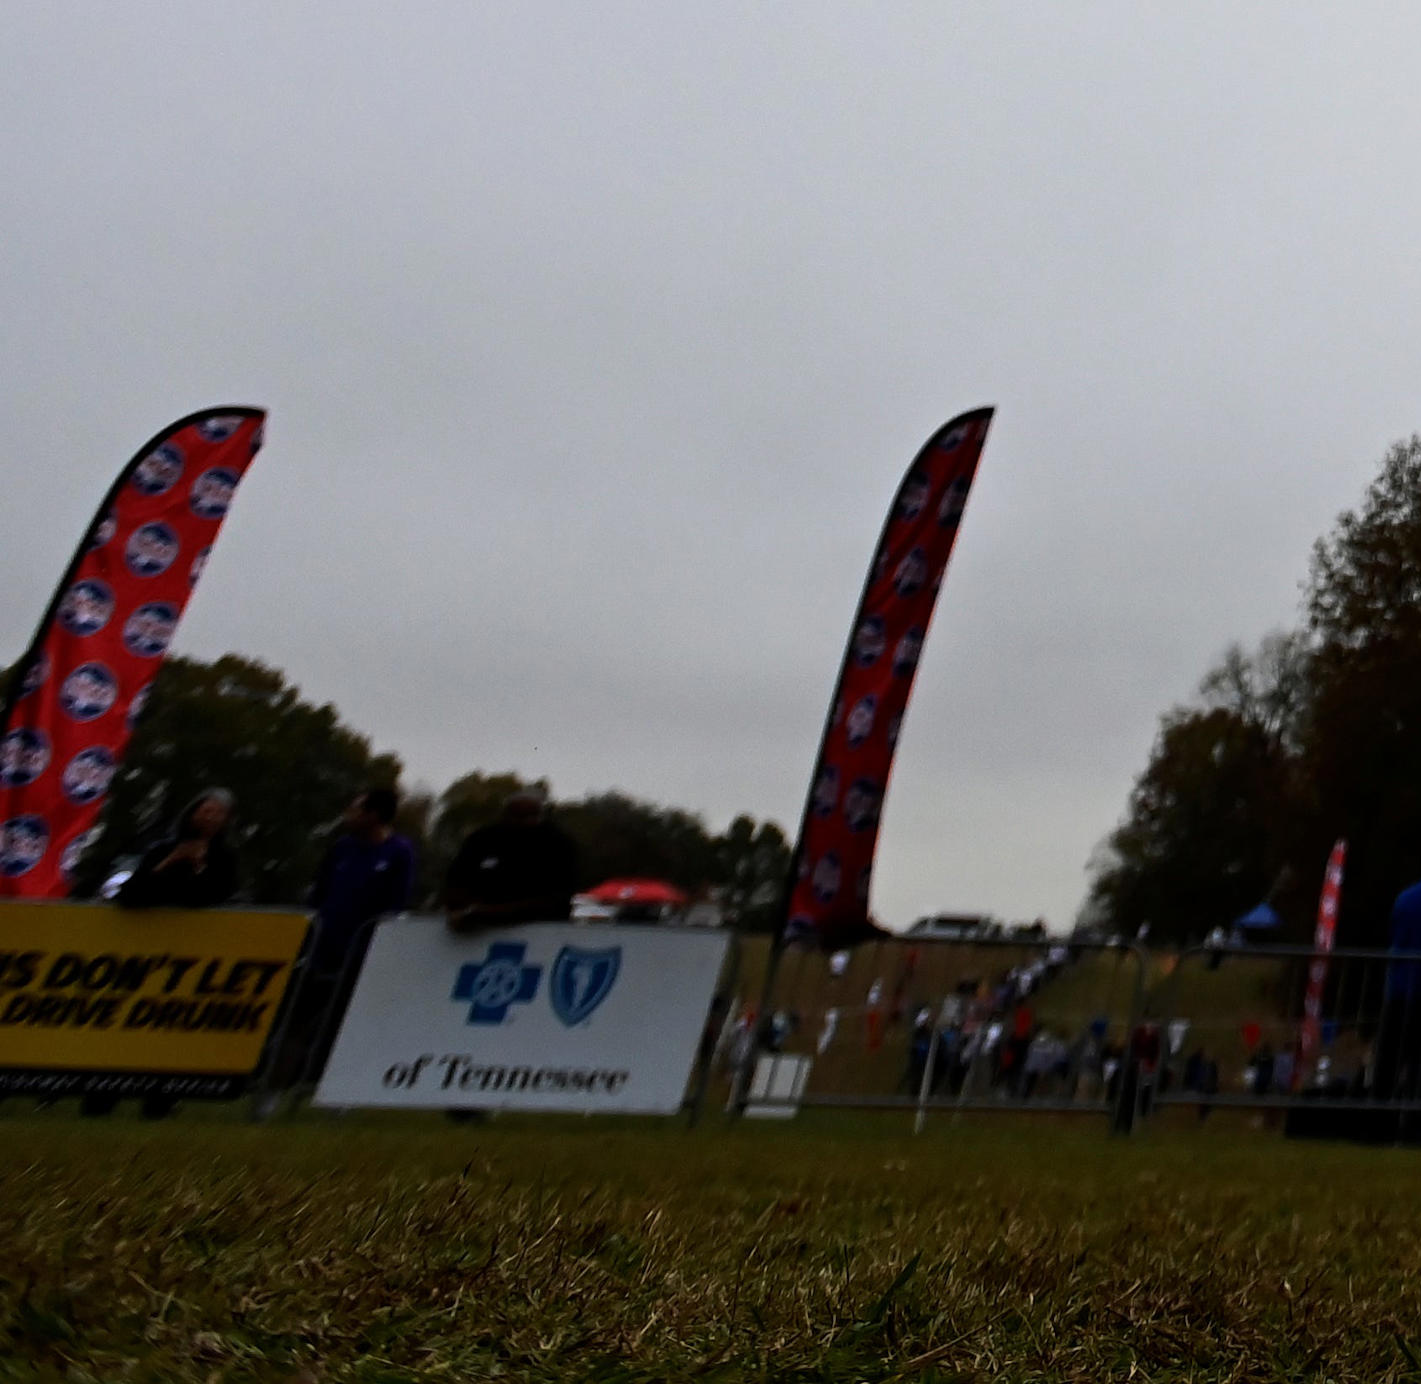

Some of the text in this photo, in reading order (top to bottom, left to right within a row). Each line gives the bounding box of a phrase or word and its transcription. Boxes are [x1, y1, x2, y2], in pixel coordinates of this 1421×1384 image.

[44, 952, 198, 993] DON'T
[197, 958, 288, 995] LET
[3, 995, 269, 1032] DRIVE DRUNK
[383, 1053, 629, 1094] of Tennessee
